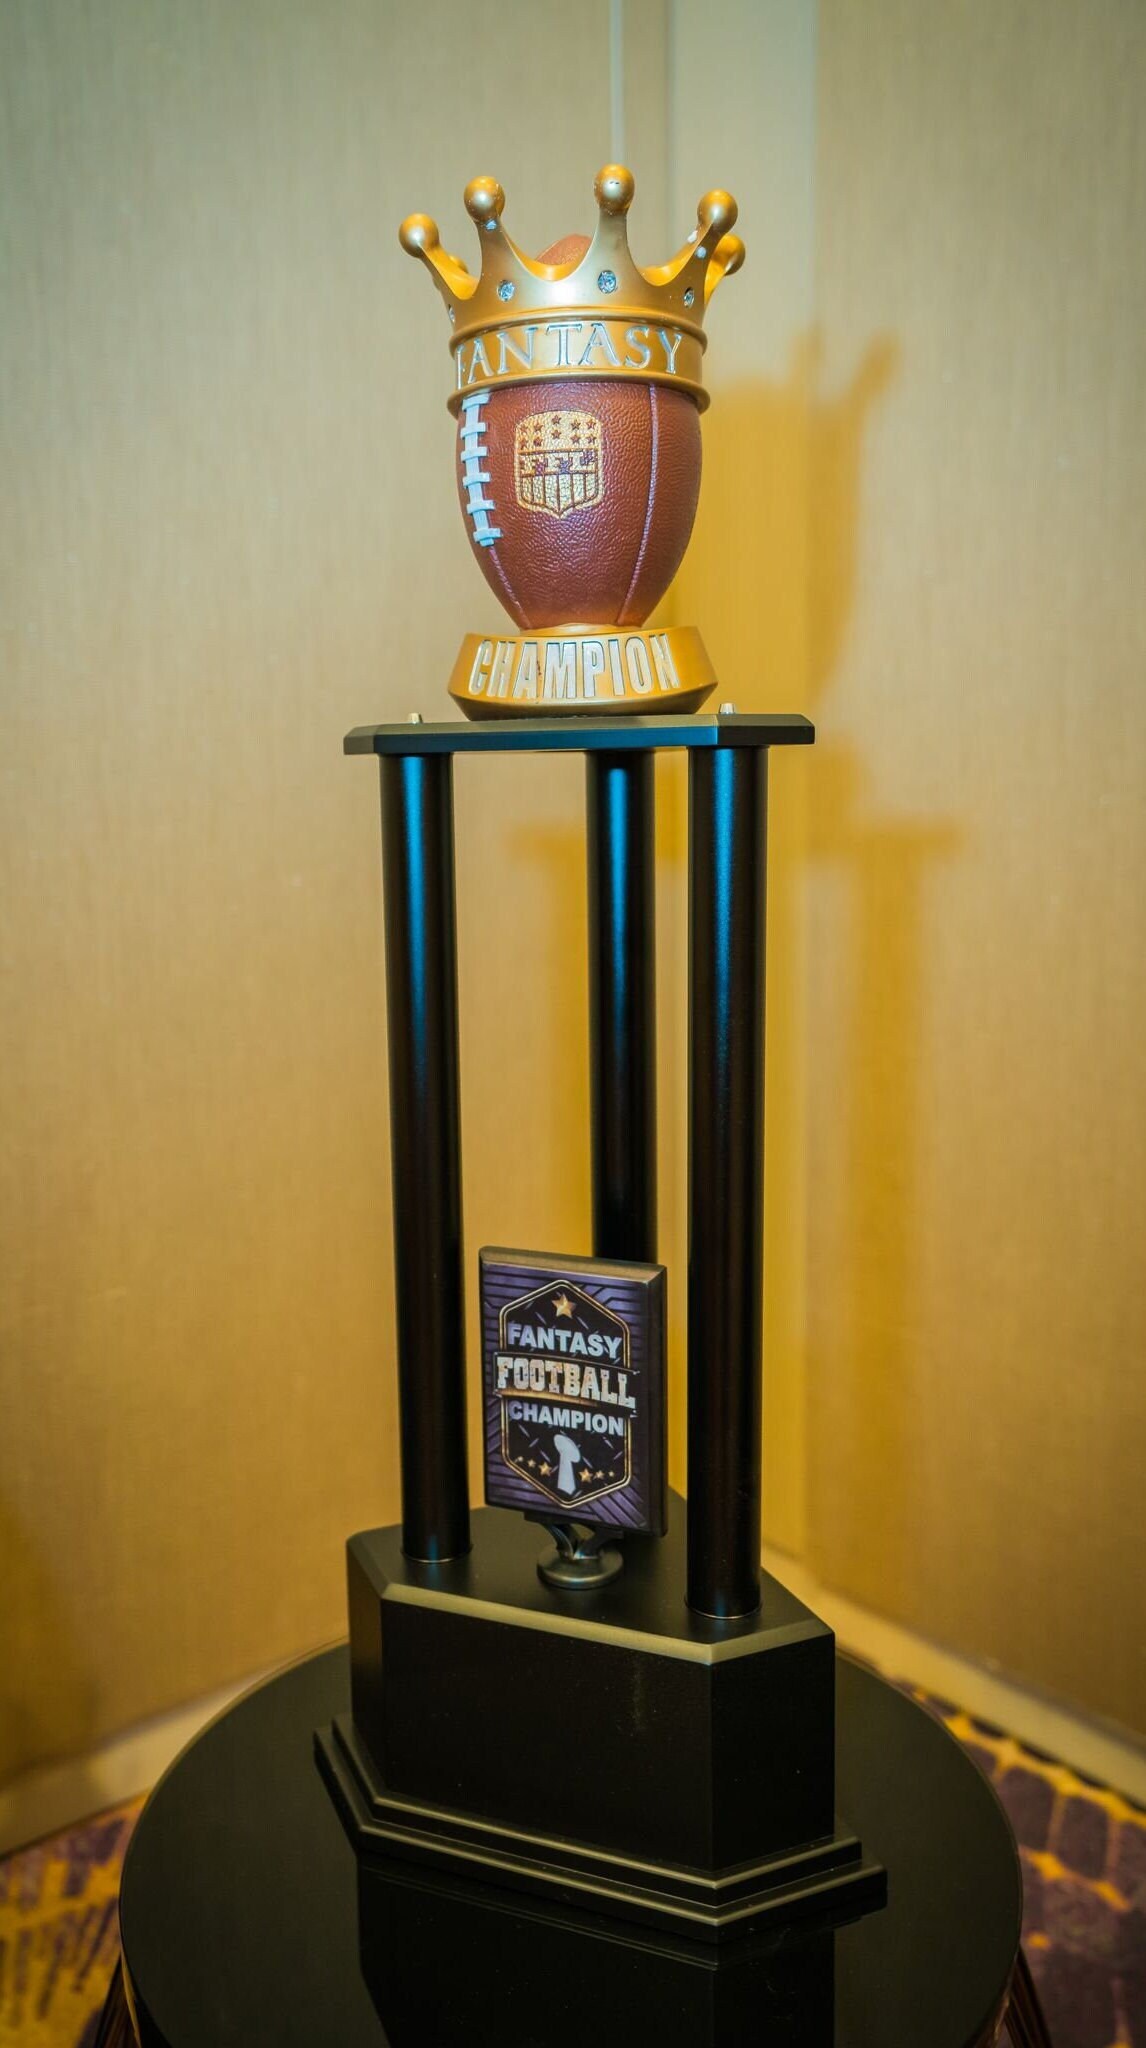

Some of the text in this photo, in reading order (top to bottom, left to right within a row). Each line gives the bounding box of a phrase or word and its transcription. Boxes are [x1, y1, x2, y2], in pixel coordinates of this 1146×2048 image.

[457, 323, 682, 389] FANTASY
[469, 633, 680, 699] CHAMPION
[507, 1323, 622, 1359] FANTASY
[497, 1356, 636, 1408] FOOTBALL
[509, 1401, 624, 1436] CHAMPION
